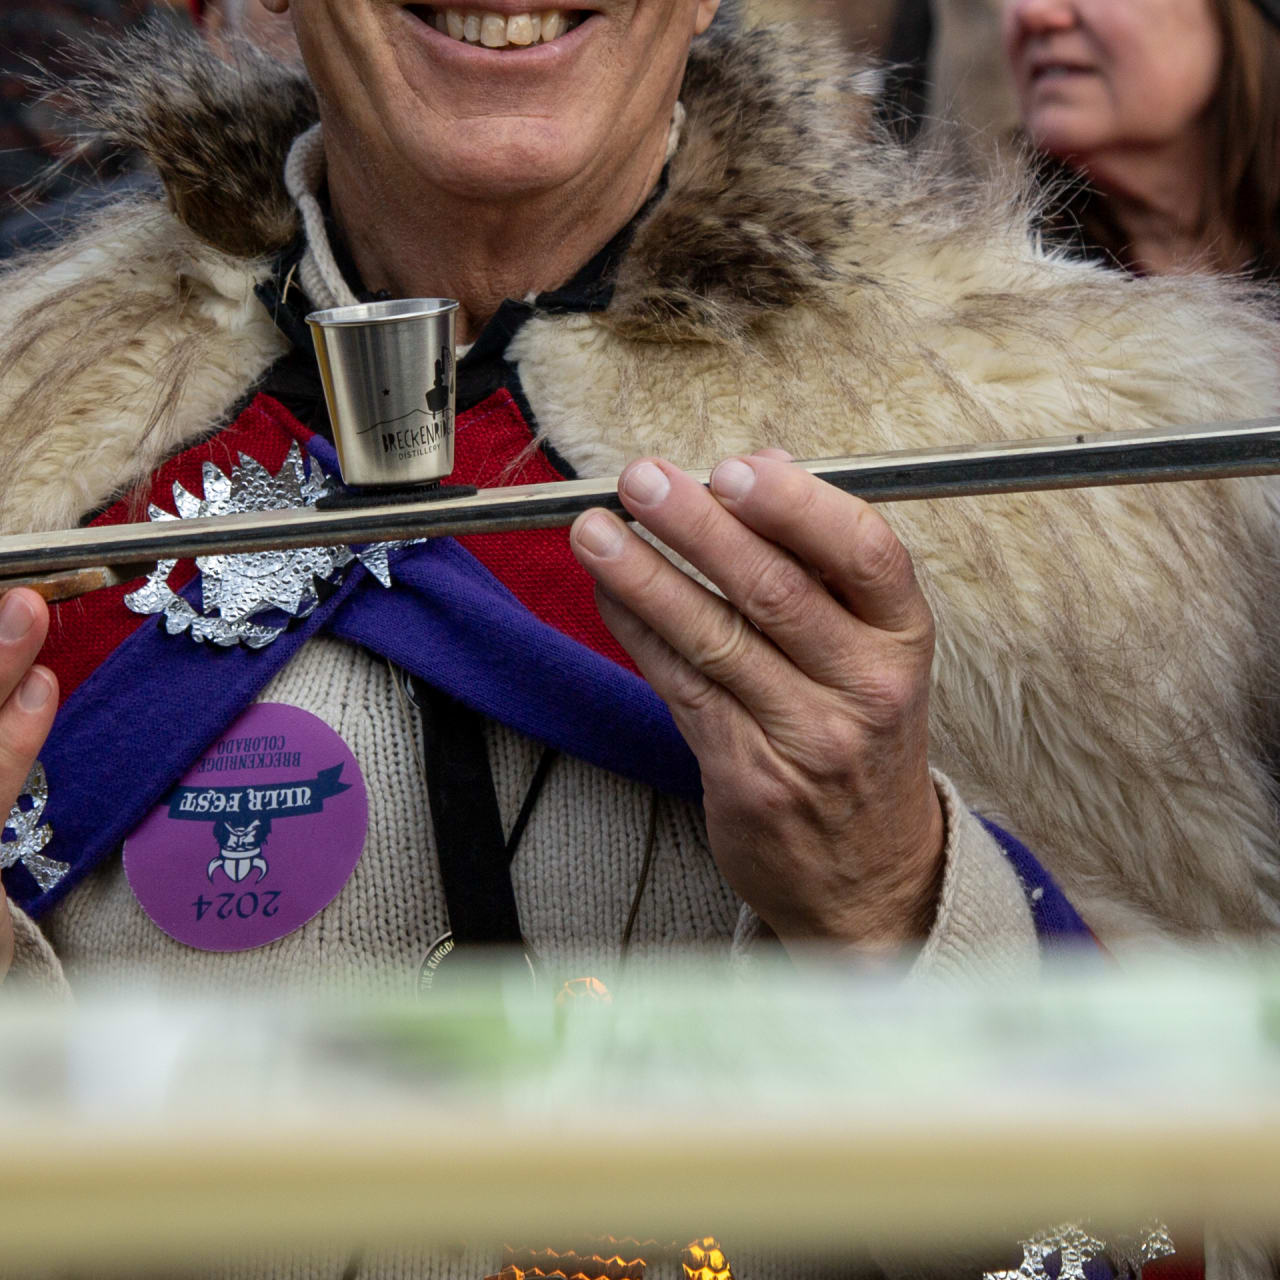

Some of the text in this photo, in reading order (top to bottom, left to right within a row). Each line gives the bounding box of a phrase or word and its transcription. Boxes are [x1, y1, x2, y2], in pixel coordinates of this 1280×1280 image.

[398, 443, 440, 461] DISTILLERY
[217, 735, 286, 755] COLORADO
[198, 751, 301, 773] BRECKENRIDGE
[178, 786, 312, 813] ULLR FEST
[192, 890, 281, 921] 2024
